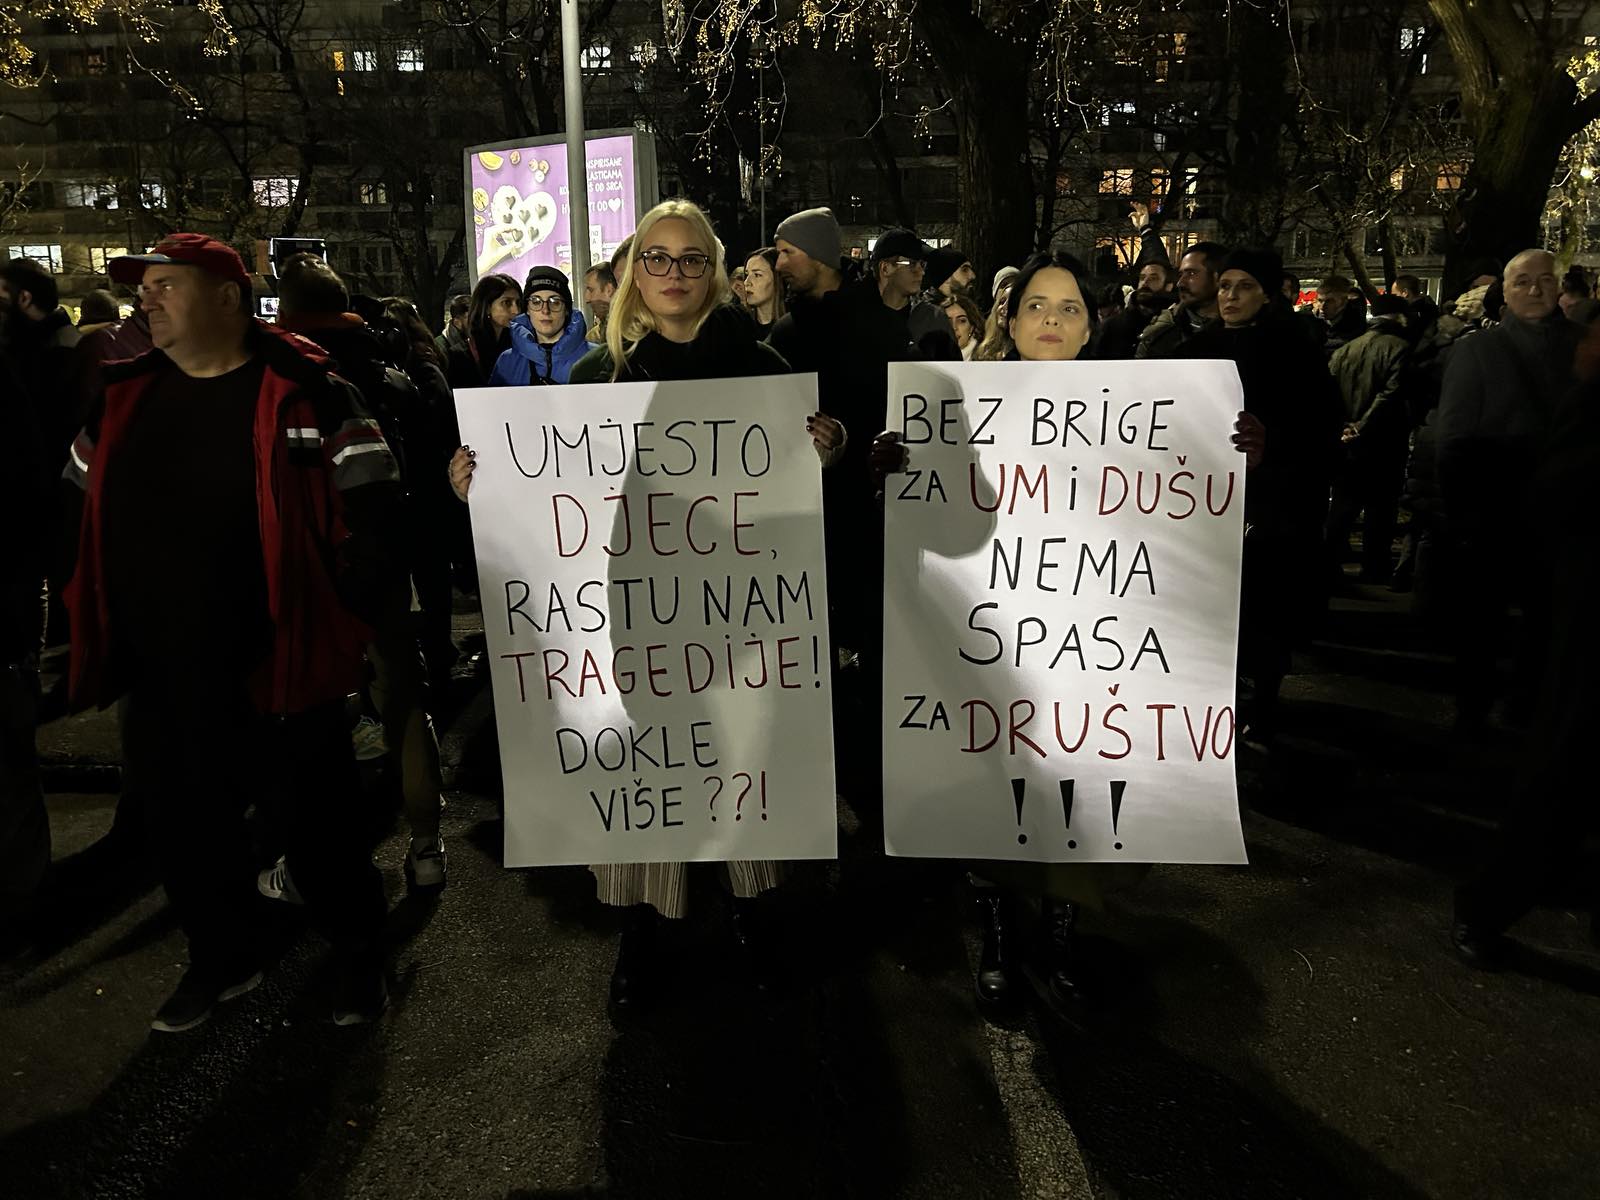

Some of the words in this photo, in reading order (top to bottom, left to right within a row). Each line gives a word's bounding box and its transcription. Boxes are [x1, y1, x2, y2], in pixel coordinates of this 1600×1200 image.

[595, 182, 605, 192] OD
[597, 200, 608, 212] OD
[505, 418, 771, 478] UMJESTO
[902, 394, 1003, 445] BEZ
[897, 470, 947, 503] ZA
[969, 463, 1049, 515] UM
[1098, 455, 1235, 519] DUŠU
[552, 486, 778, 559] DJECE,
[989, 537, 1156, 597] NEMA
[505, 576, 679, 635] RASTU
[703, 571, 814, 627] NAM
[959, 602, 1171, 674] SPASA
[555, 721, 719, 774] DOKLE
[899, 695, 951, 731] ZA
[960, 683, 1235, 762] DRUŠTVO
